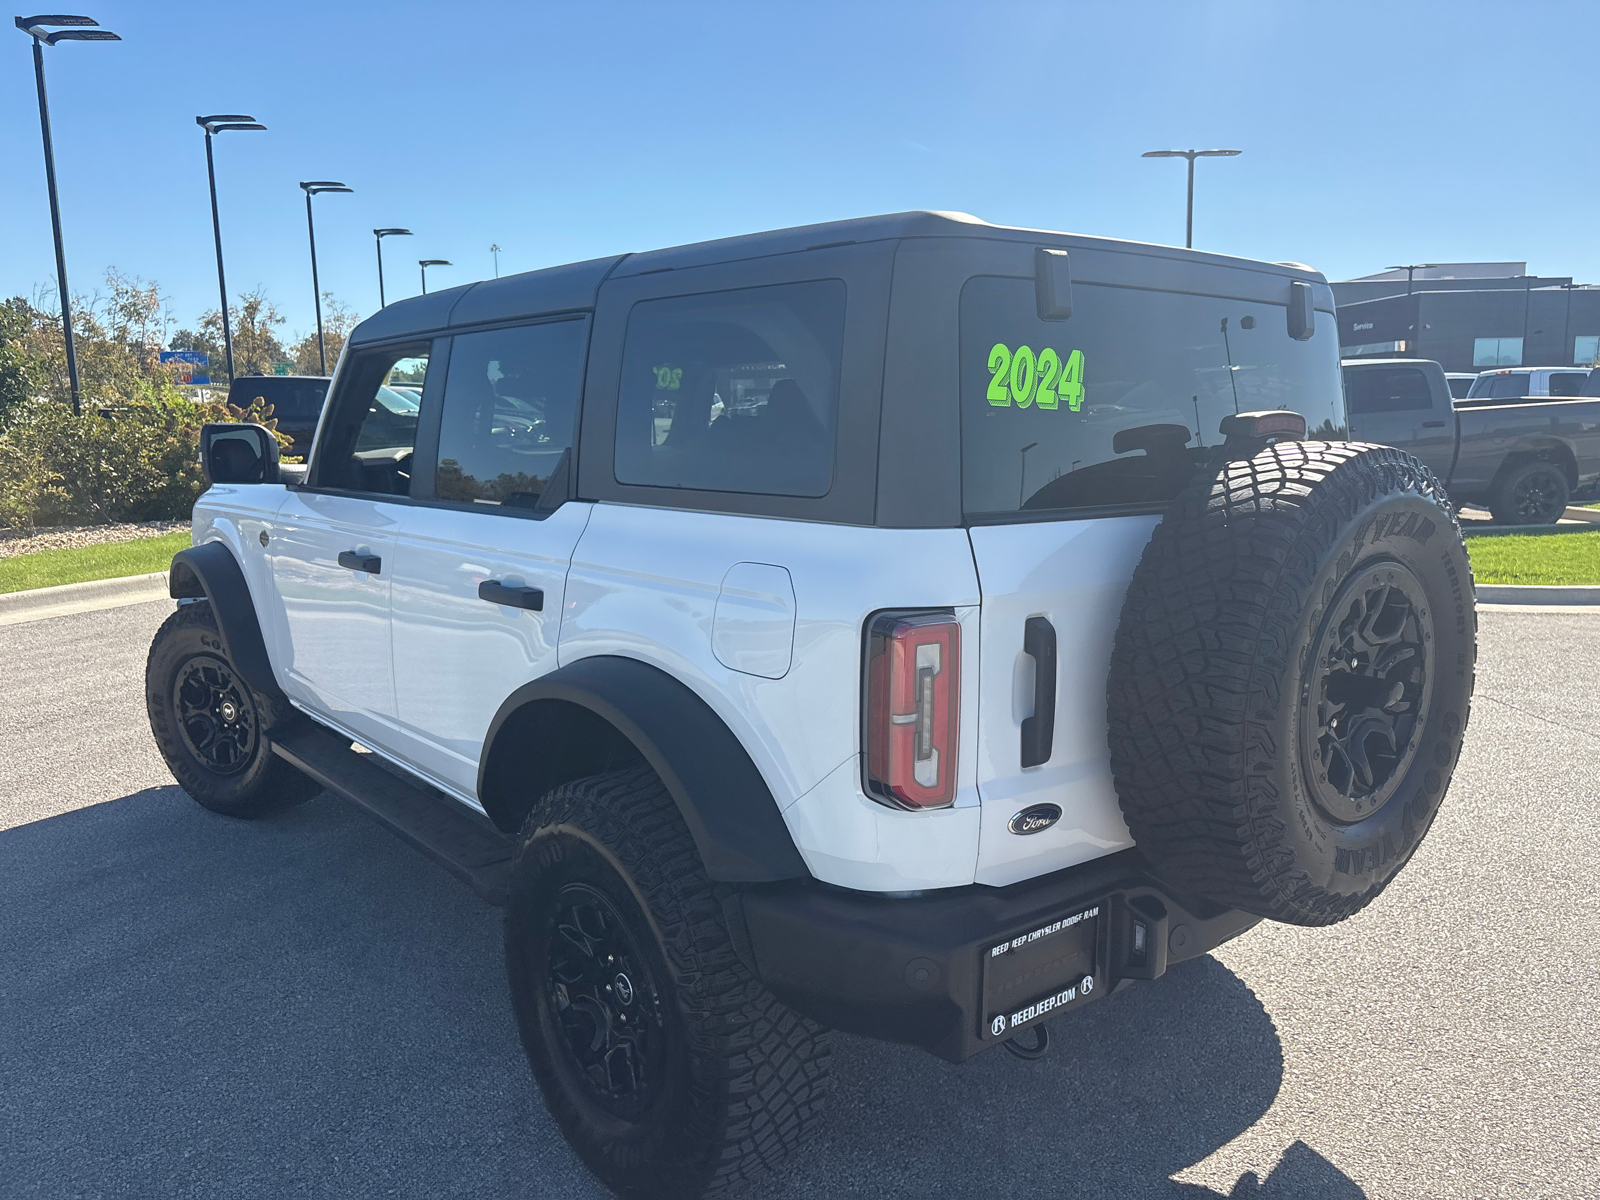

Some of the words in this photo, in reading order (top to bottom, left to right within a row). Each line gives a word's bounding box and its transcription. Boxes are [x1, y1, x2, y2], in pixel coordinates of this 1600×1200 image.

[986, 342, 1085, 412] 2024
[1440, 549, 1466, 636] TERRITORY
[1455, 652, 1465, 678] MT
[1022, 812, 1052, 831] Ford
[991, 942, 1009, 957] REED
[1011, 934, 1027, 949] JEEP
[1027, 921, 1061, 943] CHRYSLER
[1061, 911, 1083, 929] DODGE
[1083, 906, 1099, 920] RAM
[1011, 987, 1076, 1028] REEDJEEP.COM
